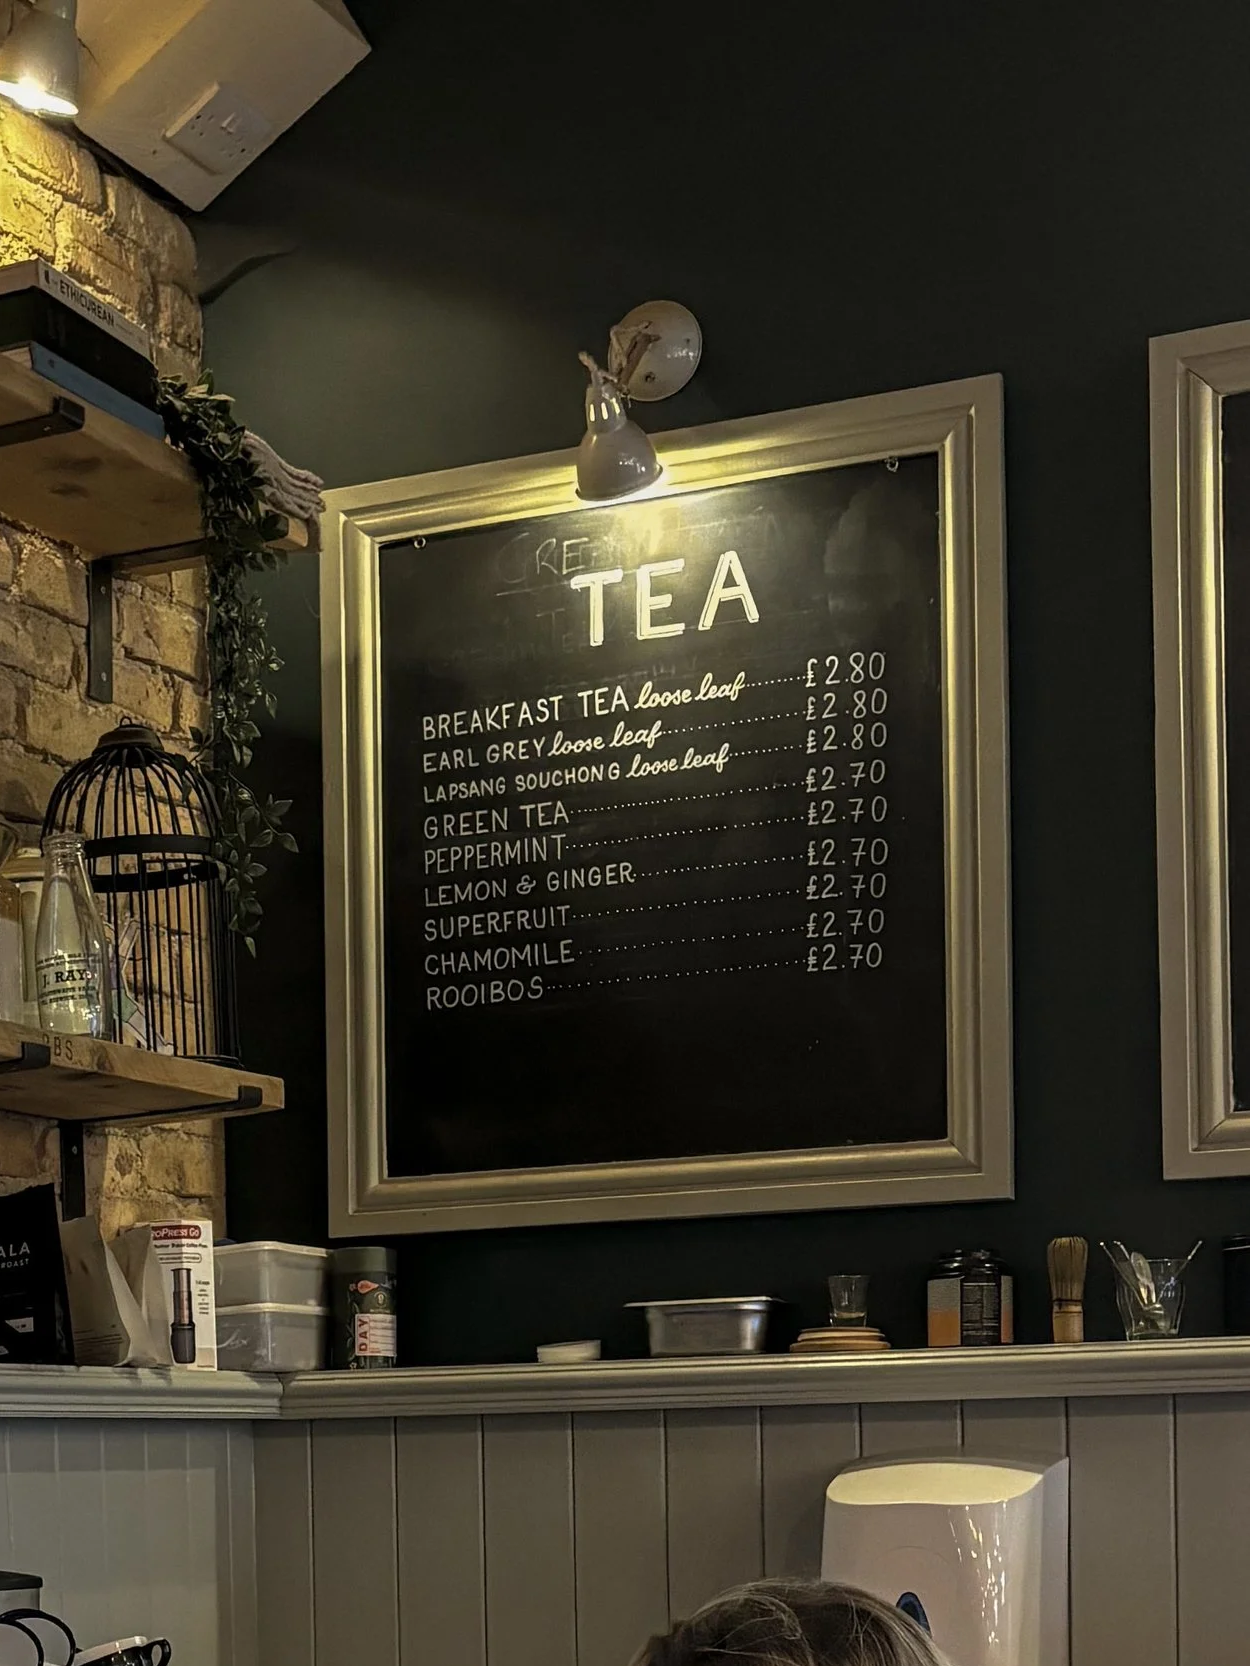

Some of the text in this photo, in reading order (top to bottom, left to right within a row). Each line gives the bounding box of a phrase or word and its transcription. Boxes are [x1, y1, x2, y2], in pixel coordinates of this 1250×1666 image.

[59, 279, 115, 328] ETHICUREAN
[569, 550, 760, 647] TEA
[422, 651, 885, 741] BREAKFAST TEA loose leaf £2.80
[423, 687, 888, 774] EARL GREY loose leaf £2.80
[424, 722, 888, 804] LAPSANG SOUCHONG loose leaf £2.80
[423, 759, 886, 840] GREEN TEA £2.70
[424, 795, 888, 875] PEPPERMINT £2.70
[424, 872, 887, 942] SUPERFRUIT £2.70
[425, 837, 889, 907] LEMON & GINGER £2.70
[424, 908, 885, 976] CHAMOMILE £2.70
[426, 942, 883, 1011] ROOIBOS £2.70
[0, 1258, 30, 1270] ROAST
[358, 1318, 368, 1352] DAY
